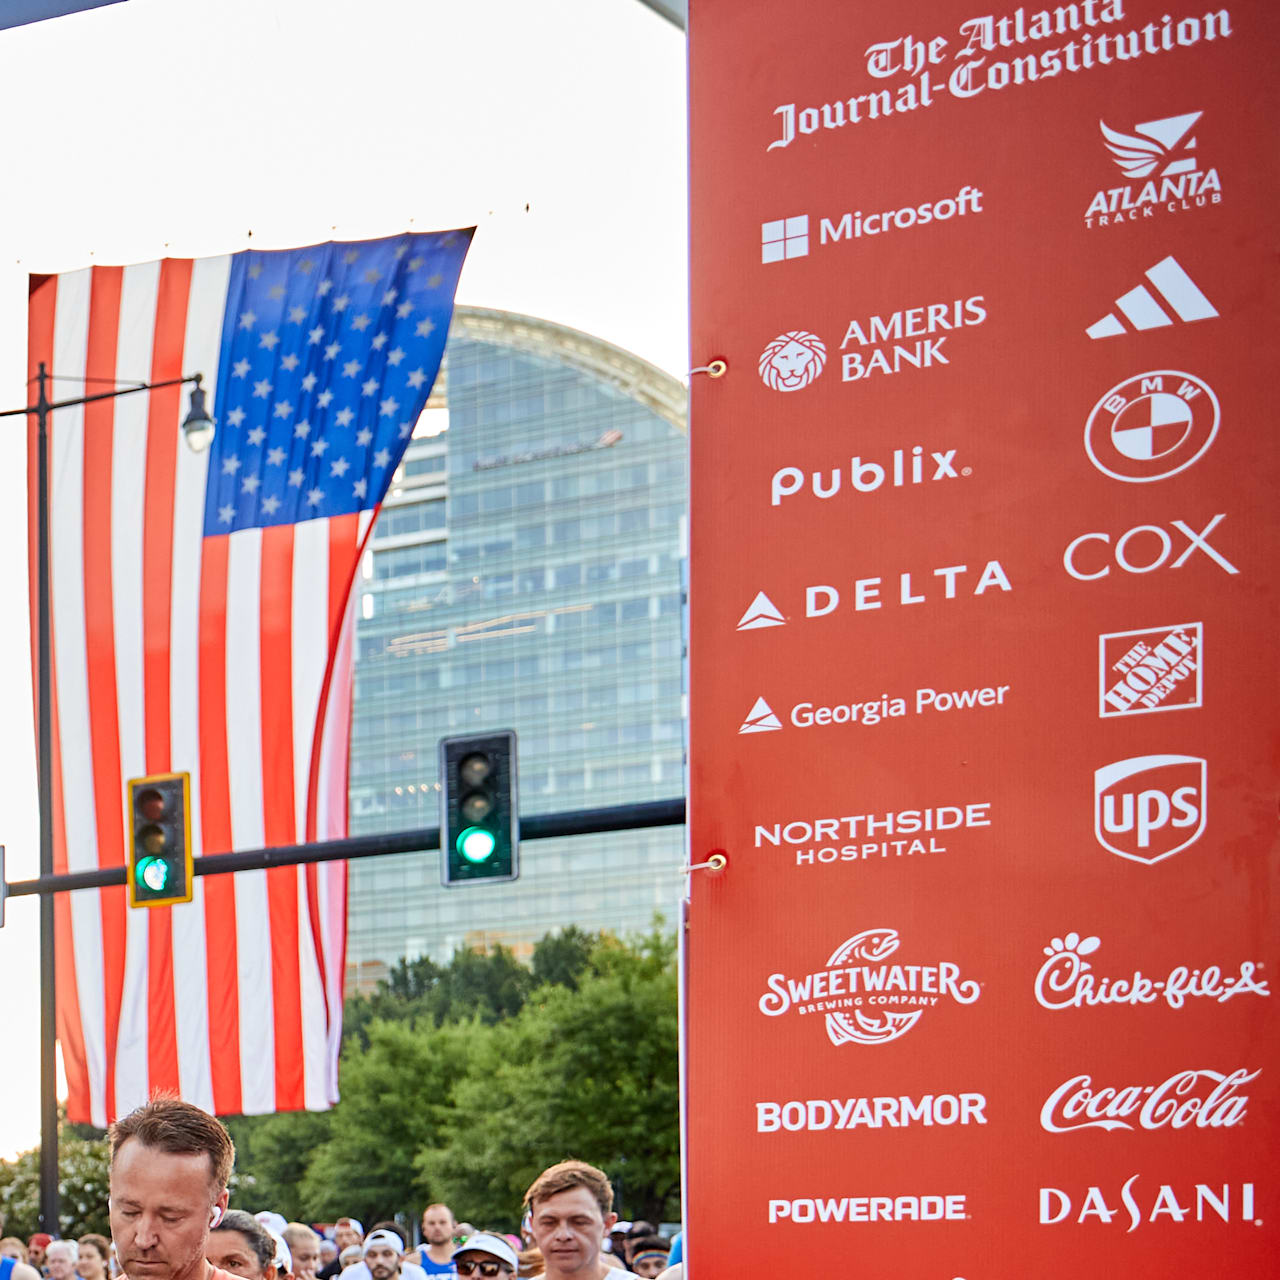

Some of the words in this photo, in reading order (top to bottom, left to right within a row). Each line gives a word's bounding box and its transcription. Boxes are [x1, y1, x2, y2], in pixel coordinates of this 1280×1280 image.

[865, 35, 948, 79] The
[960, 0, 1126, 60] Atlanta
[767, 8, 1233, 152] Journal-Constitution
[820, 187, 983, 245] Microsoft
[1084, 169, 1221, 217] ATLANTA
[1085, 205, 1154, 229] TRACK
[1167, 192, 1223, 213] CLUB
[839, 296, 987, 349] AMERIS
[841, 337, 950, 383] BANK
[1103, 376, 1201, 416] BMW
[1063, 514, 1240, 581] COX
[806, 561, 1013, 619] DELTA
[1104, 629, 1197, 712] HOME
[1112, 640, 1152, 674] THE
[1139, 655, 1197, 708] DEPOT
[791, 693, 906, 727] Georgia
[916, 684, 1010, 714] Power
[754, 803, 992, 848] NORTHSIDE
[1103, 786, 1199, 848] ups
[796, 838, 947, 866] HOSPITAL
[758, 962, 981, 1017] SWEETWATER
[1035, 946, 1271, 1011] Chick-fil-A
[798, 996, 864, 1016] BREWING
[867, 995, 939, 1010] COMPANY
[756, 1093, 988, 1133] BODYARMOR
[1040, 1069, 1263, 1133] Coca-Cola
[768, 1194, 967, 1224] POWERADE
[1039, 1174, 1256, 1234] DASANI
